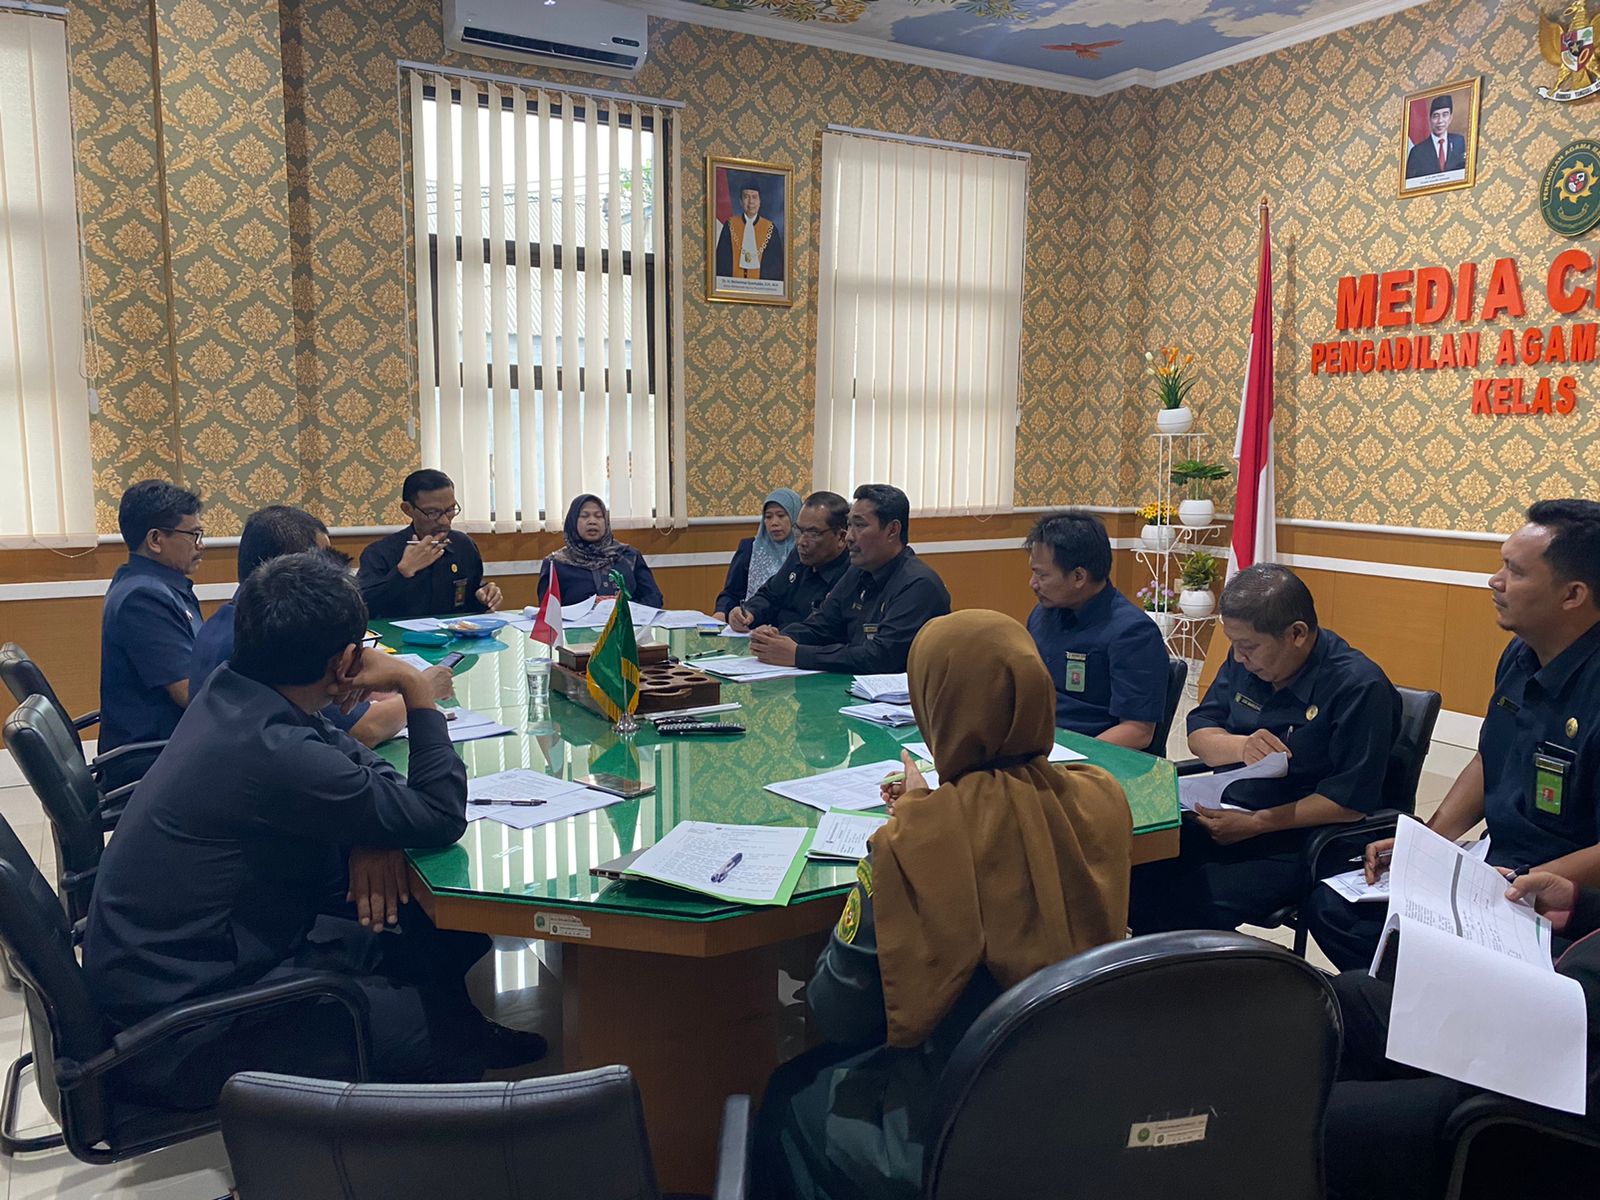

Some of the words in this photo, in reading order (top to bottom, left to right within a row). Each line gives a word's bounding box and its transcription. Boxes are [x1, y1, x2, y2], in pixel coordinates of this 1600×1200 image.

[1564, 143, 1591, 156] AGAMA
[1336, 257, 1526, 330] MEDIA
[1547, 249, 1600, 314] C
[1311, 331, 1480, 376] PENGADILAN
[1471, 376, 1578, 416] KELAS
